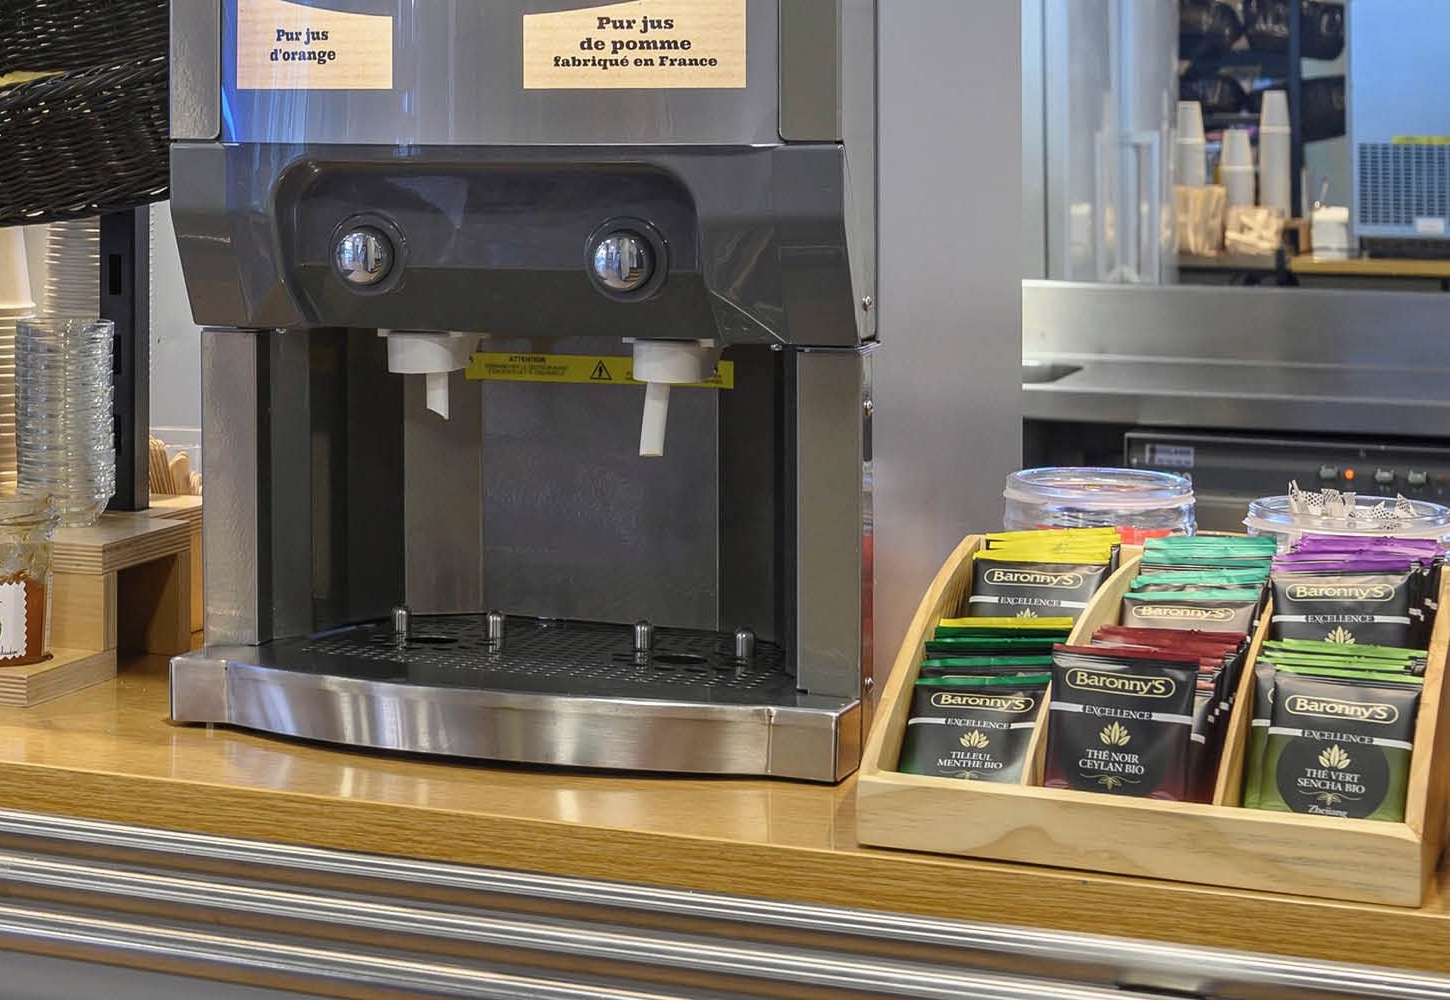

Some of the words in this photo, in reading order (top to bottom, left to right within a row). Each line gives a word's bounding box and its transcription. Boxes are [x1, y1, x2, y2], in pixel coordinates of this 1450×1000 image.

[597, 16, 636, 30] Pur
[639, 15, 674, 33] jus
[276, 28, 302, 41] Pur
[304, 27, 329, 45] jus
[579, 38, 606, 51] de
[611, 39, 692, 54] pomme
[270, 48, 336, 64] d'orange
[553, 55, 629, 70] fabriqué
[633, 58, 655, 67] en
[658, 56, 718, 67] France
[1000, 596, 1061, 607] EXCELLENCE
[1308, 614, 1374, 625] EXCELLENCE
[1085, 704, 1151, 721] EXCELLENCE
[946, 718, 1011, 729] EXCELLENCE
[1303, 729, 1372, 745] EXCELLENCE
[937, 759, 983, 769] MENTHE
[984, 761, 1003, 769] BIO
[950, 751, 992, 761] TILLEUL
[1086, 748, 1110, 761] THÉ
[1110, 752, 1140, 764] NOIR
[1078, 759, 1124, 774] CEYLAN
[1124, 765, 1145, 775] BIO
[1305, 767, 1329, 780] THÉ
[1330, 771, 1361, 783] VERT
[1297, 778, 1342, 792] SENCHA
[1344, 783, 1366, 795] BIO
